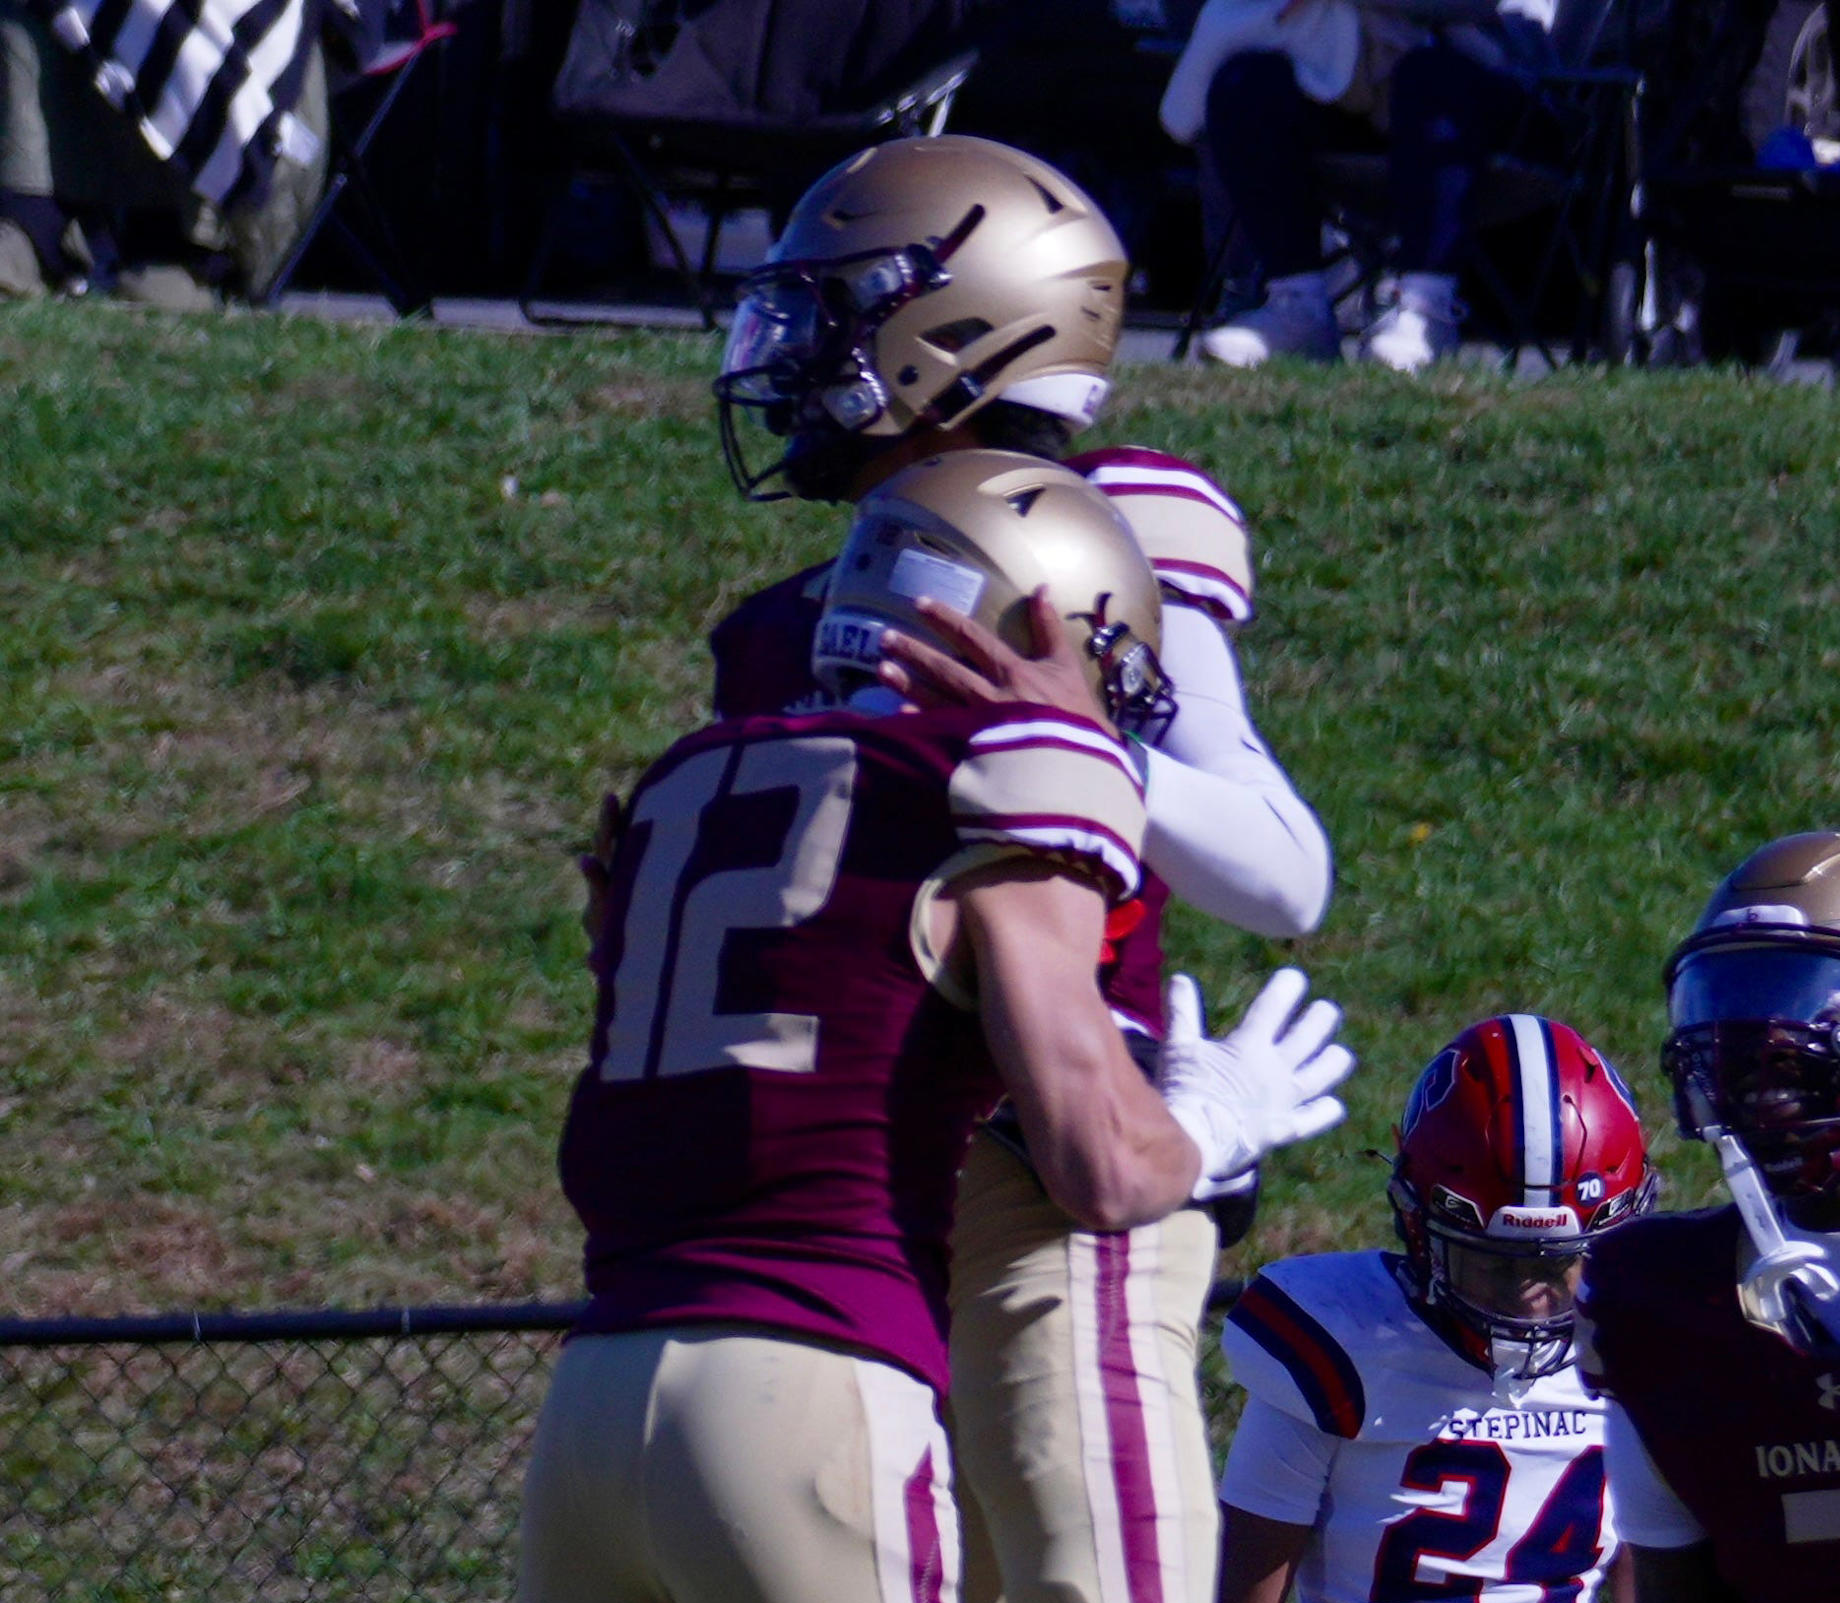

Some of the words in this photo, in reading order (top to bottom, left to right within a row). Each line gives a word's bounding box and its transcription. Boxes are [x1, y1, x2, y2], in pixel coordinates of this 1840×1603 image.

[601, 737, 858, 1081] 12
[1578, 1178, 1601, 1200] 70
[1502, 1212, 1568, 1229] Riddell
[1449, 1409, 1588, 1443] STEPINAC
